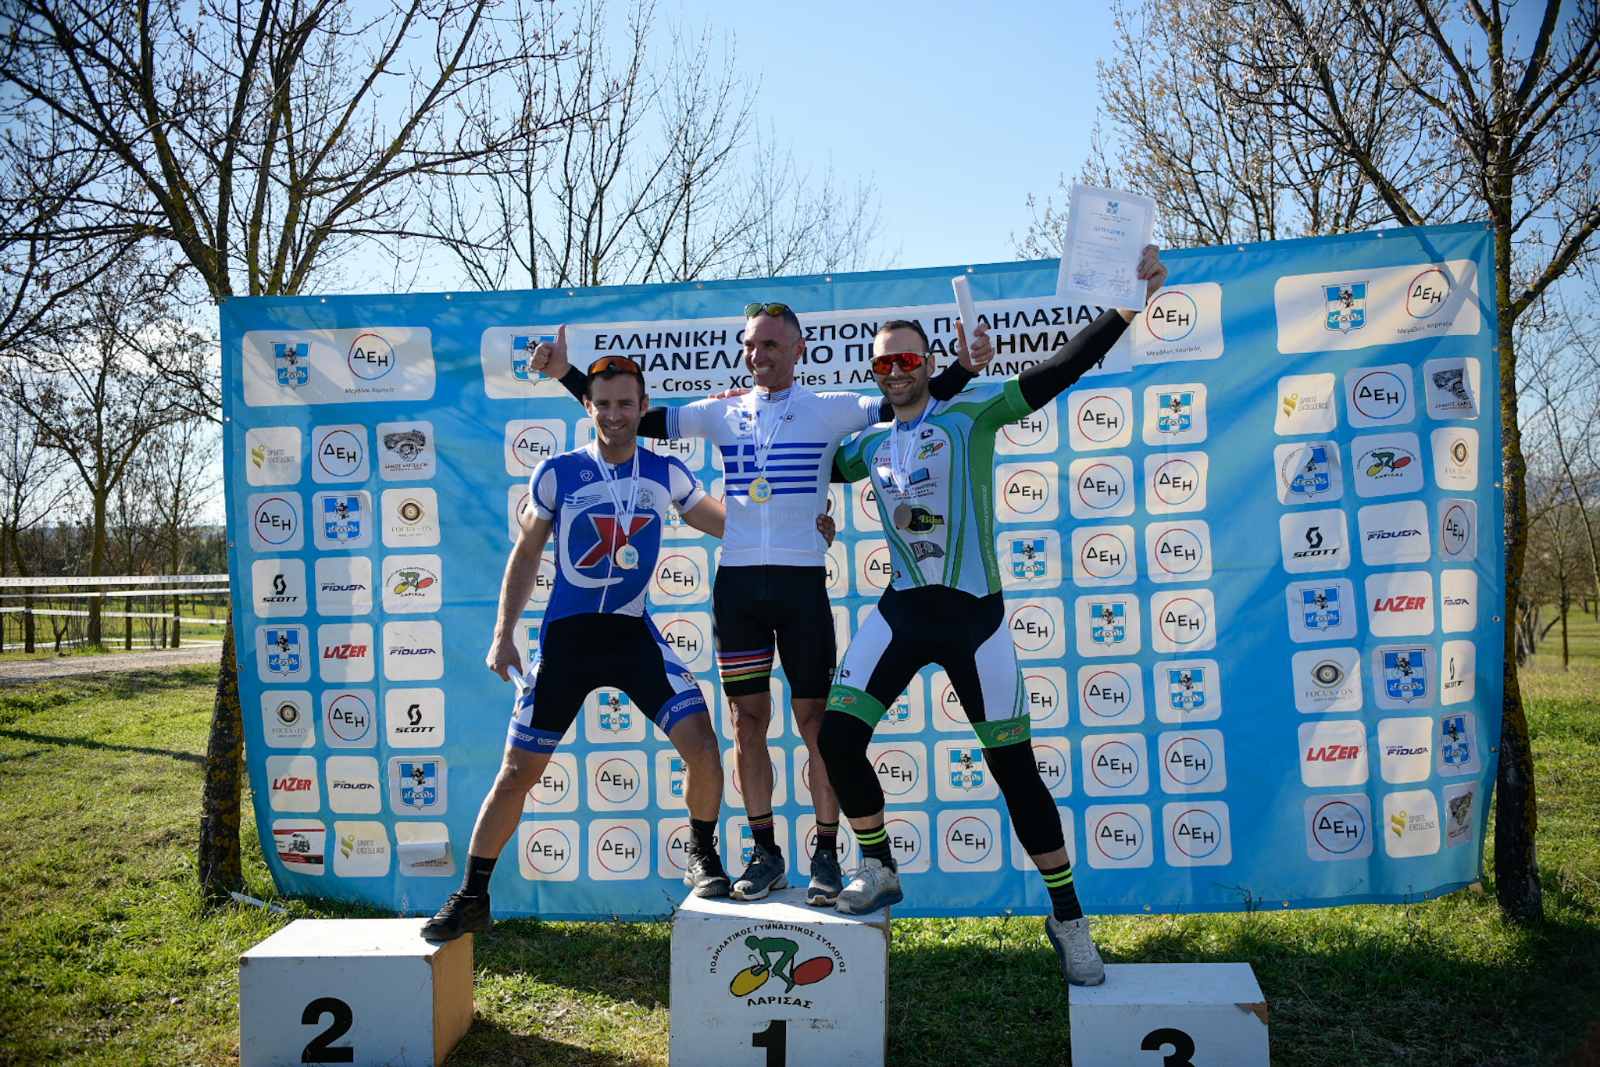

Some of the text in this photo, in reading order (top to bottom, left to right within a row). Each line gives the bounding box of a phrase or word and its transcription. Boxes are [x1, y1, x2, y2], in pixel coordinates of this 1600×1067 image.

[1412, 285, 1442, 303] ΔΕΗ
[1152, 307, 1189, 326] ΔΕΗ
[594, 330, 727, 350] ΕΛΛΗΝΙΚΗ
[934, 305, 1105, 333] ΠΔΗΛΑΣΙΑΣ
[354, 348, 388, 366] ΔΕΗ
[628, 345, 833, 372] ΠΑΝΕΛΙΟ
[662, 378, 712, 392] Cross
[730, 376, 752, 389] XC
[794, 372, 826, 385] ries
[1359, 386, 1398, 404] ΔΕΗ
[1083, 410, 1117, 428] ΔΕΗ
[324, 444, 356, 462] ΔΕΗ
[518, 439, 550, 455] ΔΕΗ
[1084, 477, 1118, 495] ΔΕΗ
[1160, 473, 1192, 490] ΔΕΗ
[1010, 483, 1042, 499] ΔΕΗ
[259, 512, 290, 530] ΔΕΗ
[1446, 520, 1464, 541] ΔΕΗ
[1087, 547, 1120, 564] ΔΕΗ
[1160, 543, 1195, 560] ΔΕΗ
[1292, 548, 1340, 558] SCOTT
[870, 560, 892, 574] ΔΕ
[536, 575, 554, 590] ΕΗ
[661, 568, 693, 586] ΔΕΗ
[1374, 596, 1426, 612] LAZER
[1014, 619, 1048, 637] ΔΕΗ
[1165, 612, 1199, 630] ΔΕΗ
[324, 644, 367, 660] LAZER
[1030, 692, 1052, 707] ΕΗ
[1090, 685, 1124, 703] ΔΕΗ
[333, 708, 364, 728] ΔΕΗ
[396, 726, 436, 734] SCOTT
[1171, 752, 1206, 770] ΔΕΗ
[1306, 744, 1360, 762] LAZER
[878, 763, 911, 781] ΔΕΗ
[1038, 762, 1059, 776] ΕΗ
[1097, 755, 1132, 773] ΔΕΗ
[272, 778, 312, 792] LAZER
[537, 777, 564, 792] ΕΗ
[601, 771, 633, 789] ΔΕΗ
[1101, 826, 1136, 846] ΔΕΗ
[1179, 824, 1214, 843] ΔΕΗ
[1319, 817, 1357, 838] ΔΕΗ
[602, 840, 634, 858] ΔΕΗ
[672, 838, 690, 852] ΔΕ
[952, 830, 985, 850] ΔΕΗ
[531, 841, 564, 860] ΔΕΗ
[747, 996, 814, 1009] ΛΑΡΙΣΑΣ
[301, 997, 354, 1063] 2
[752, 1019, 787, 1067] 1
[1141, 1027, 1196, 1067] 3
